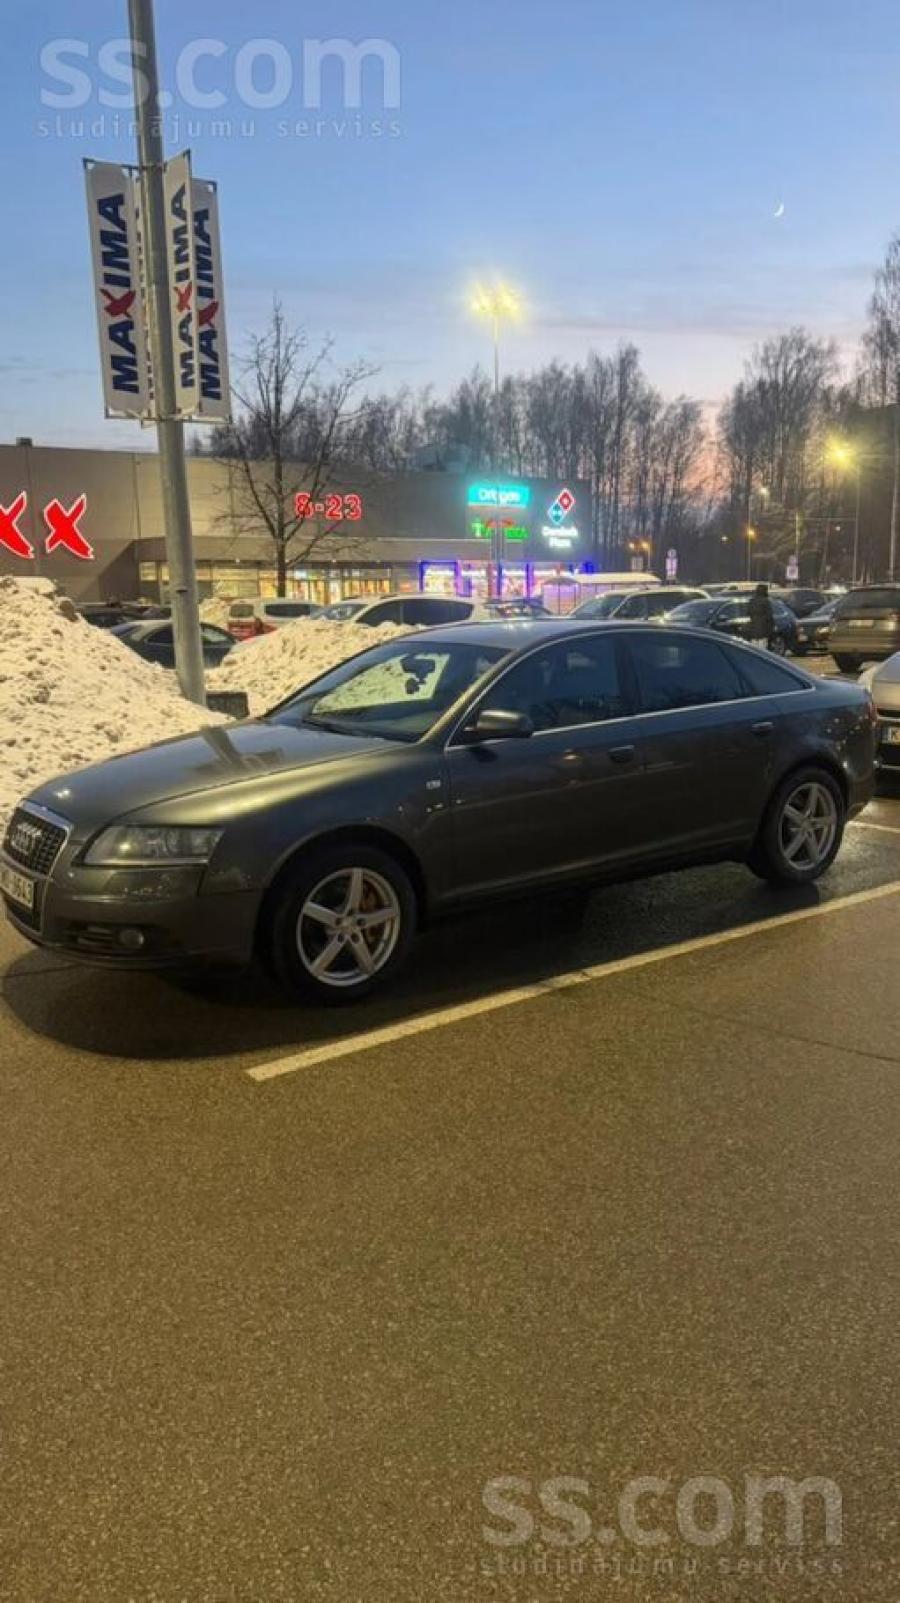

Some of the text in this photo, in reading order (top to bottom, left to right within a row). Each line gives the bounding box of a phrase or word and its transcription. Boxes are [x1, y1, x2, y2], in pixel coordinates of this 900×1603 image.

[97, 193, 140, 394] MAXIMA
[171, 183, 195, 388] MAXIMA
[194, 208, 218, 400] MAXIMA
